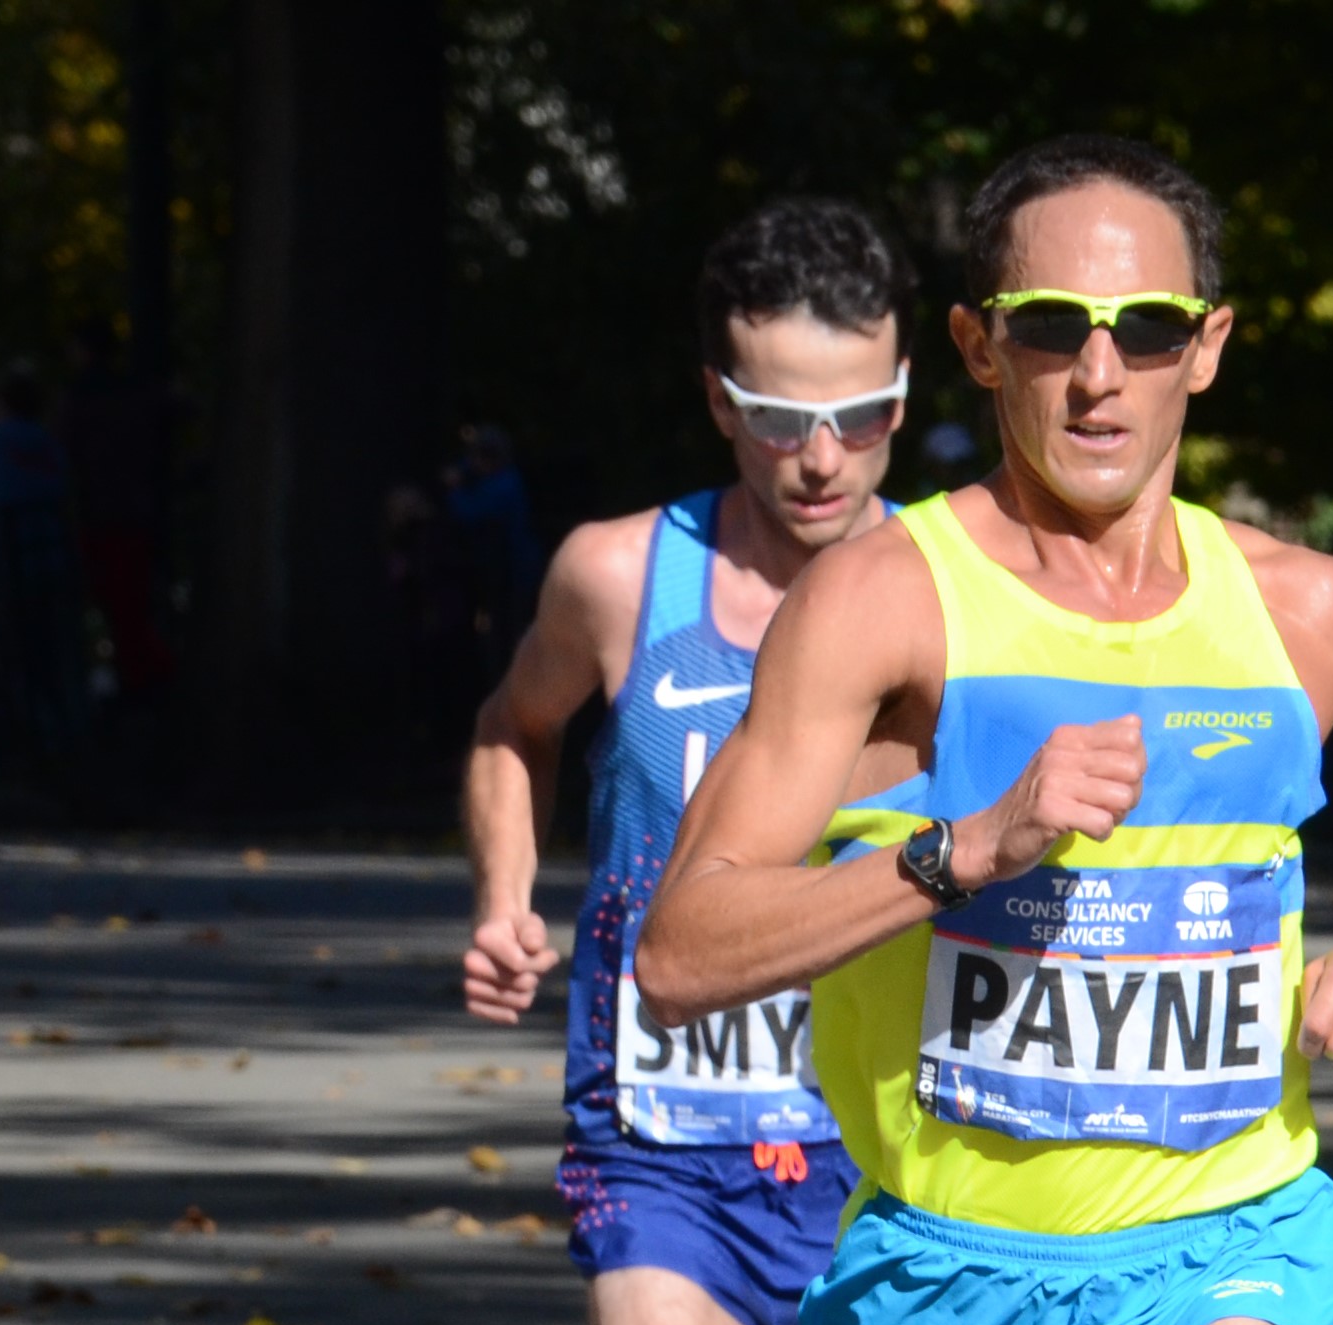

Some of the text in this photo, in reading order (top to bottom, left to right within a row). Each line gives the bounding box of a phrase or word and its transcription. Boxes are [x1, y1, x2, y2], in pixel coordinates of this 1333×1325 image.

[1163, 711, 1273, 729] BROOKS
[1051, 878, 1113, 899] TATA
[1005, 897, 1152, 923] CONSULTANCY
[1030, 924, 1126, 947] SERVICES
[1175, 919, 1234, 941] TATA
[949, 951, 1261, 1072] PAYNE
